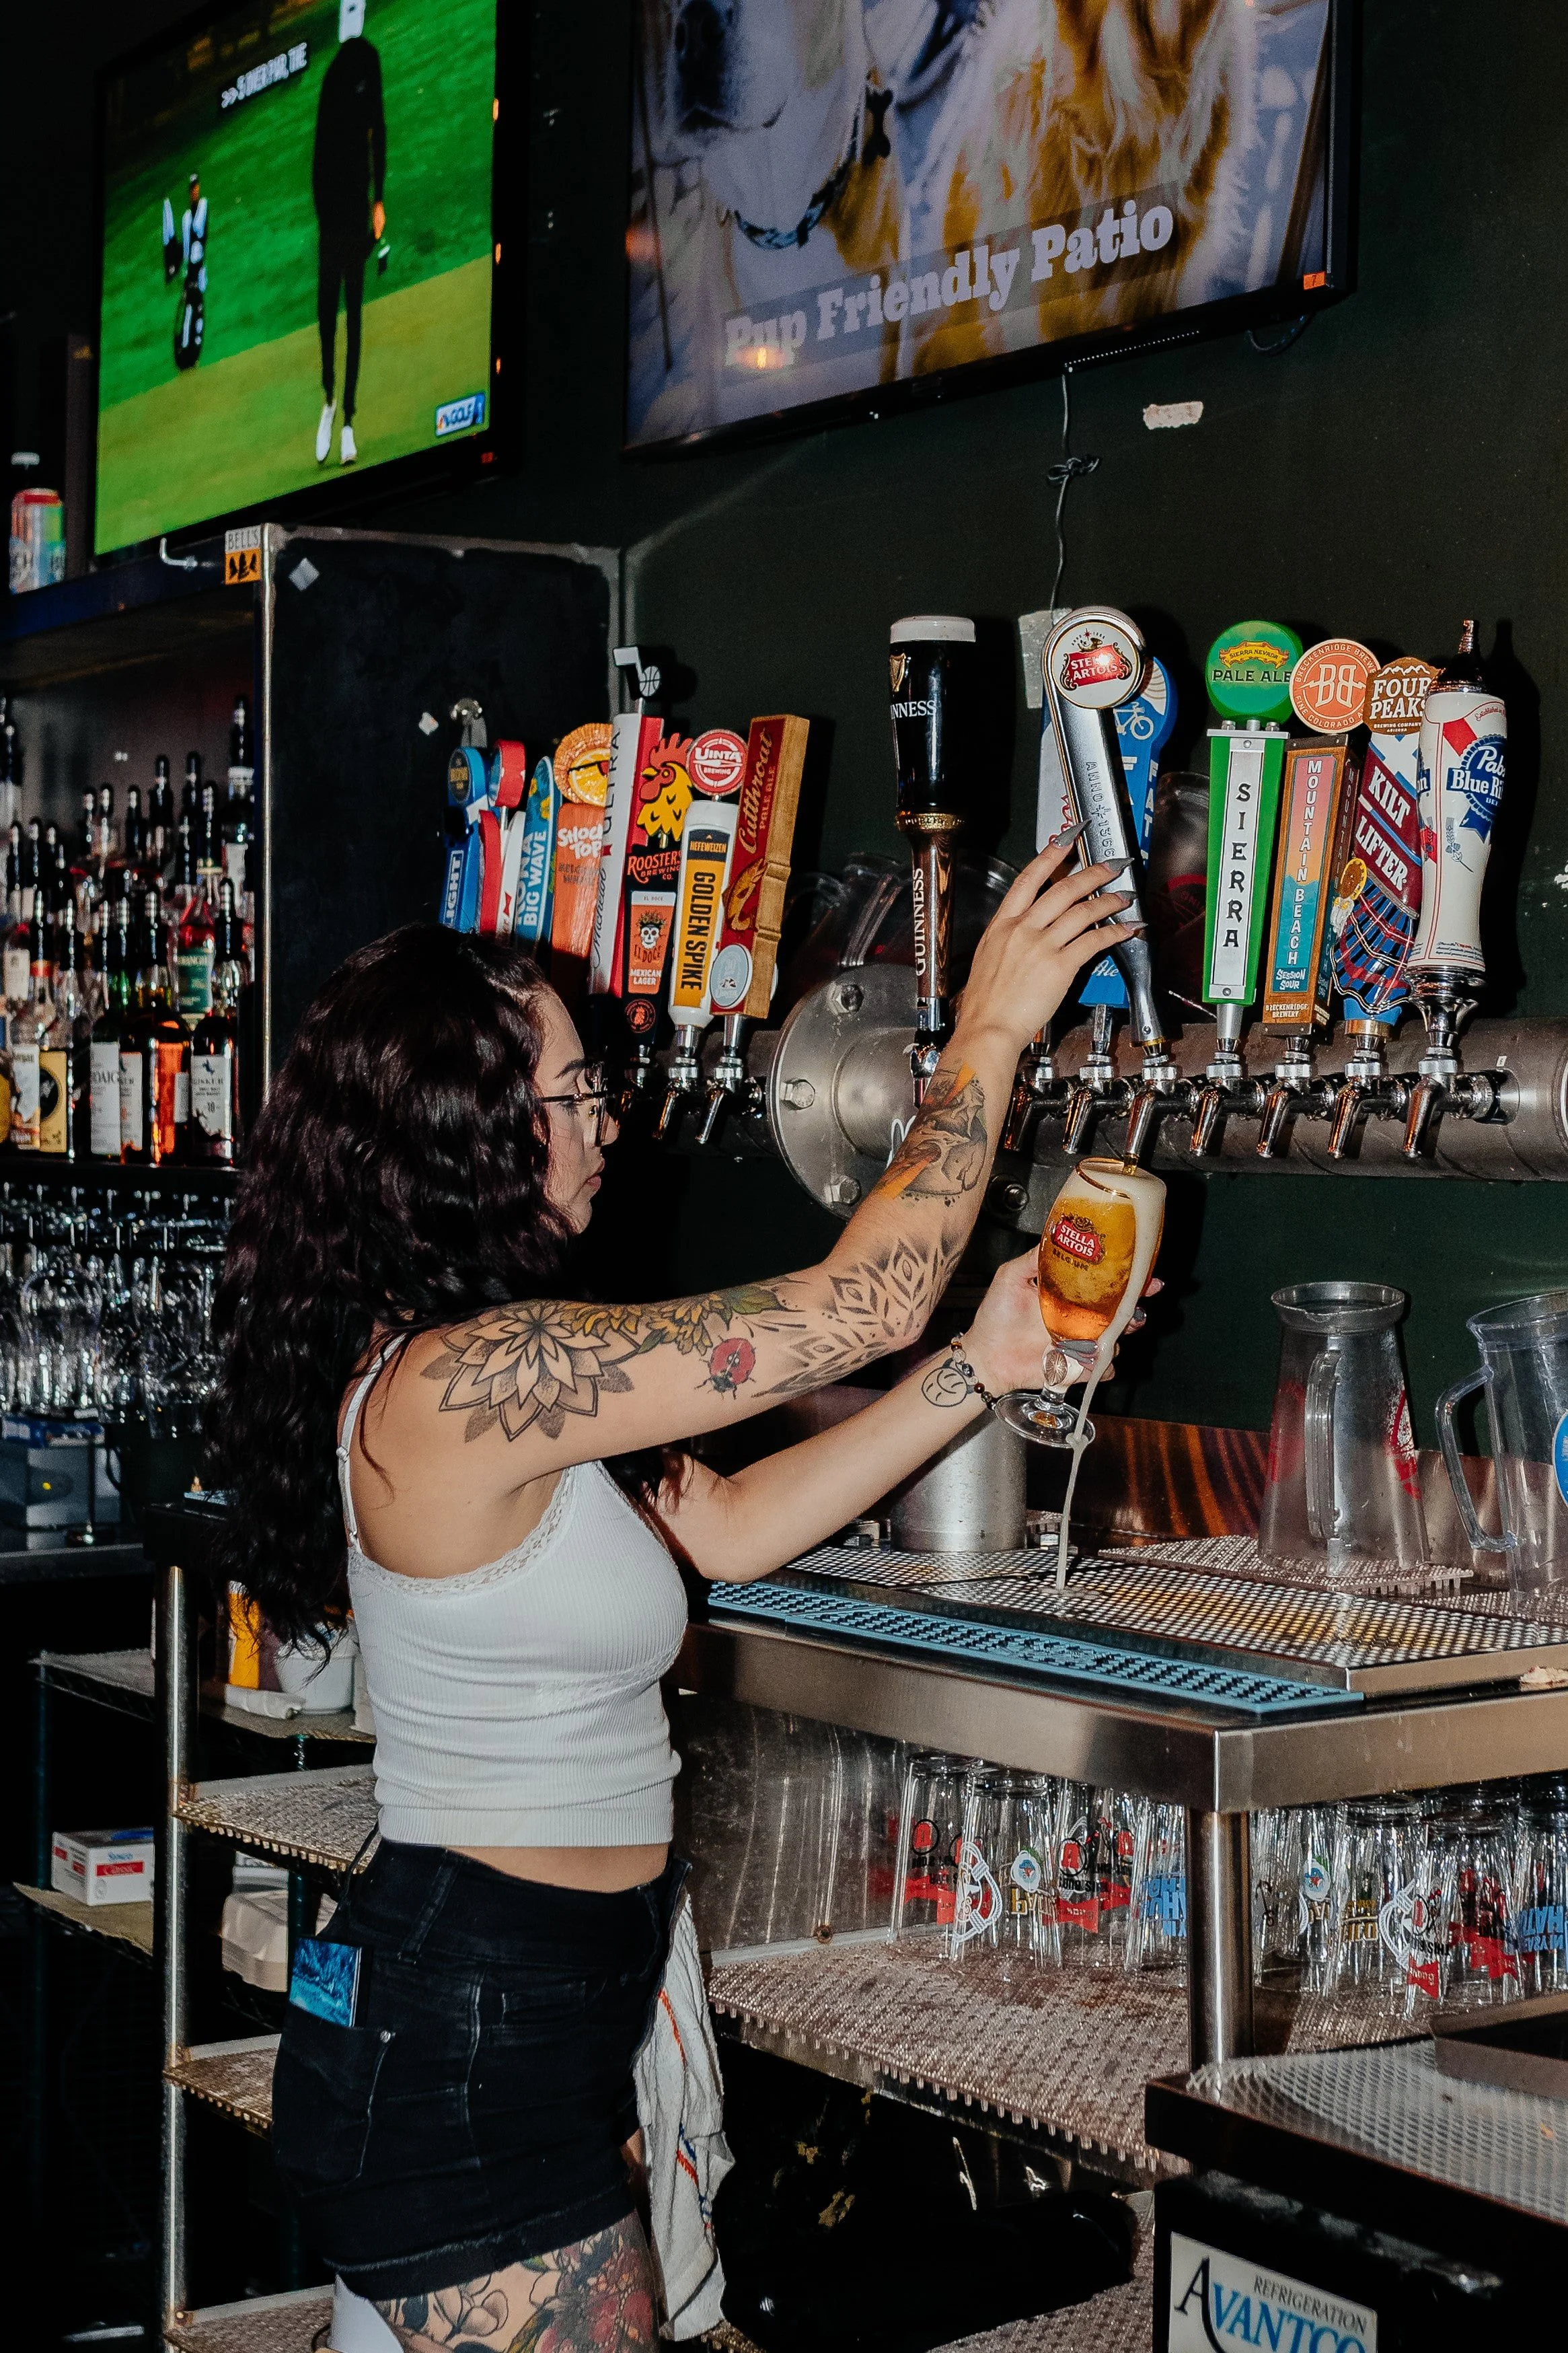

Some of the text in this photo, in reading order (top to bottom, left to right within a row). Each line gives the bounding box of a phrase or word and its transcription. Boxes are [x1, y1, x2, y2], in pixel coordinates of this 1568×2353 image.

[725, 201, 1173, 367] Pup Friendly Patio
[1229, 648, 1279, 661] SIERRA NEVADA
[1295, 643, 1377, 683] BRECKENRIDGE BREWE
[1073, 663, 1118, 680] ARTOIS
[1211, 669, 1291, 682] PALE ALE
[1372, 677, 1431, 701] FOUR
[1295, 695, 1355, 728] FINE COLORADO
[694, 747, 743, 763] UINTA
[703, 766, 732, 775] BREWING
[1086, 761, 1104, 803] ANNO
[1450, 768, 1489, 795] Blue
[738, 727, 775, 854] Cutthroat
[1144, 758, 1159, 838] FAT
[1368, 766, 1411, 828] KILT
[1296, 760, 1323, 882] MOUNTAIN
[568, 840, 602, 859] TOP
[689, 841, 727, 853] HEFEWEIZEN
[1355, 815, 1408, 892] LIFTER
[640, 865, 680, 878] BREWING
[1222, 783, 1252, 948] SIERRA
[523, 830, 548, 927] BIG WAVE
[679, 871, 716, 992] GOLDEN SPIKE
[913, 867, 926, 976] GUINNESS
[1287, 887, 1306, 966] BEACH
[630, 968, 662, 978] MEXICAN
[633, 976, 657, 986] LAGER
[1275, 968, 1306, 981] SESSION
[1279, 980, 1300, 991] SOUR
[1265, 1003, 1308, 1013] BRECKENRIDGE
[1272, 1010, 1300, 1019] BREWERY
[1057, 1233, 1094, 1258] ARTOIS
[1060, 1224, 1095, 1249] STELLA
[1253, 2274, 1368, 2336] REFRIGERATION
